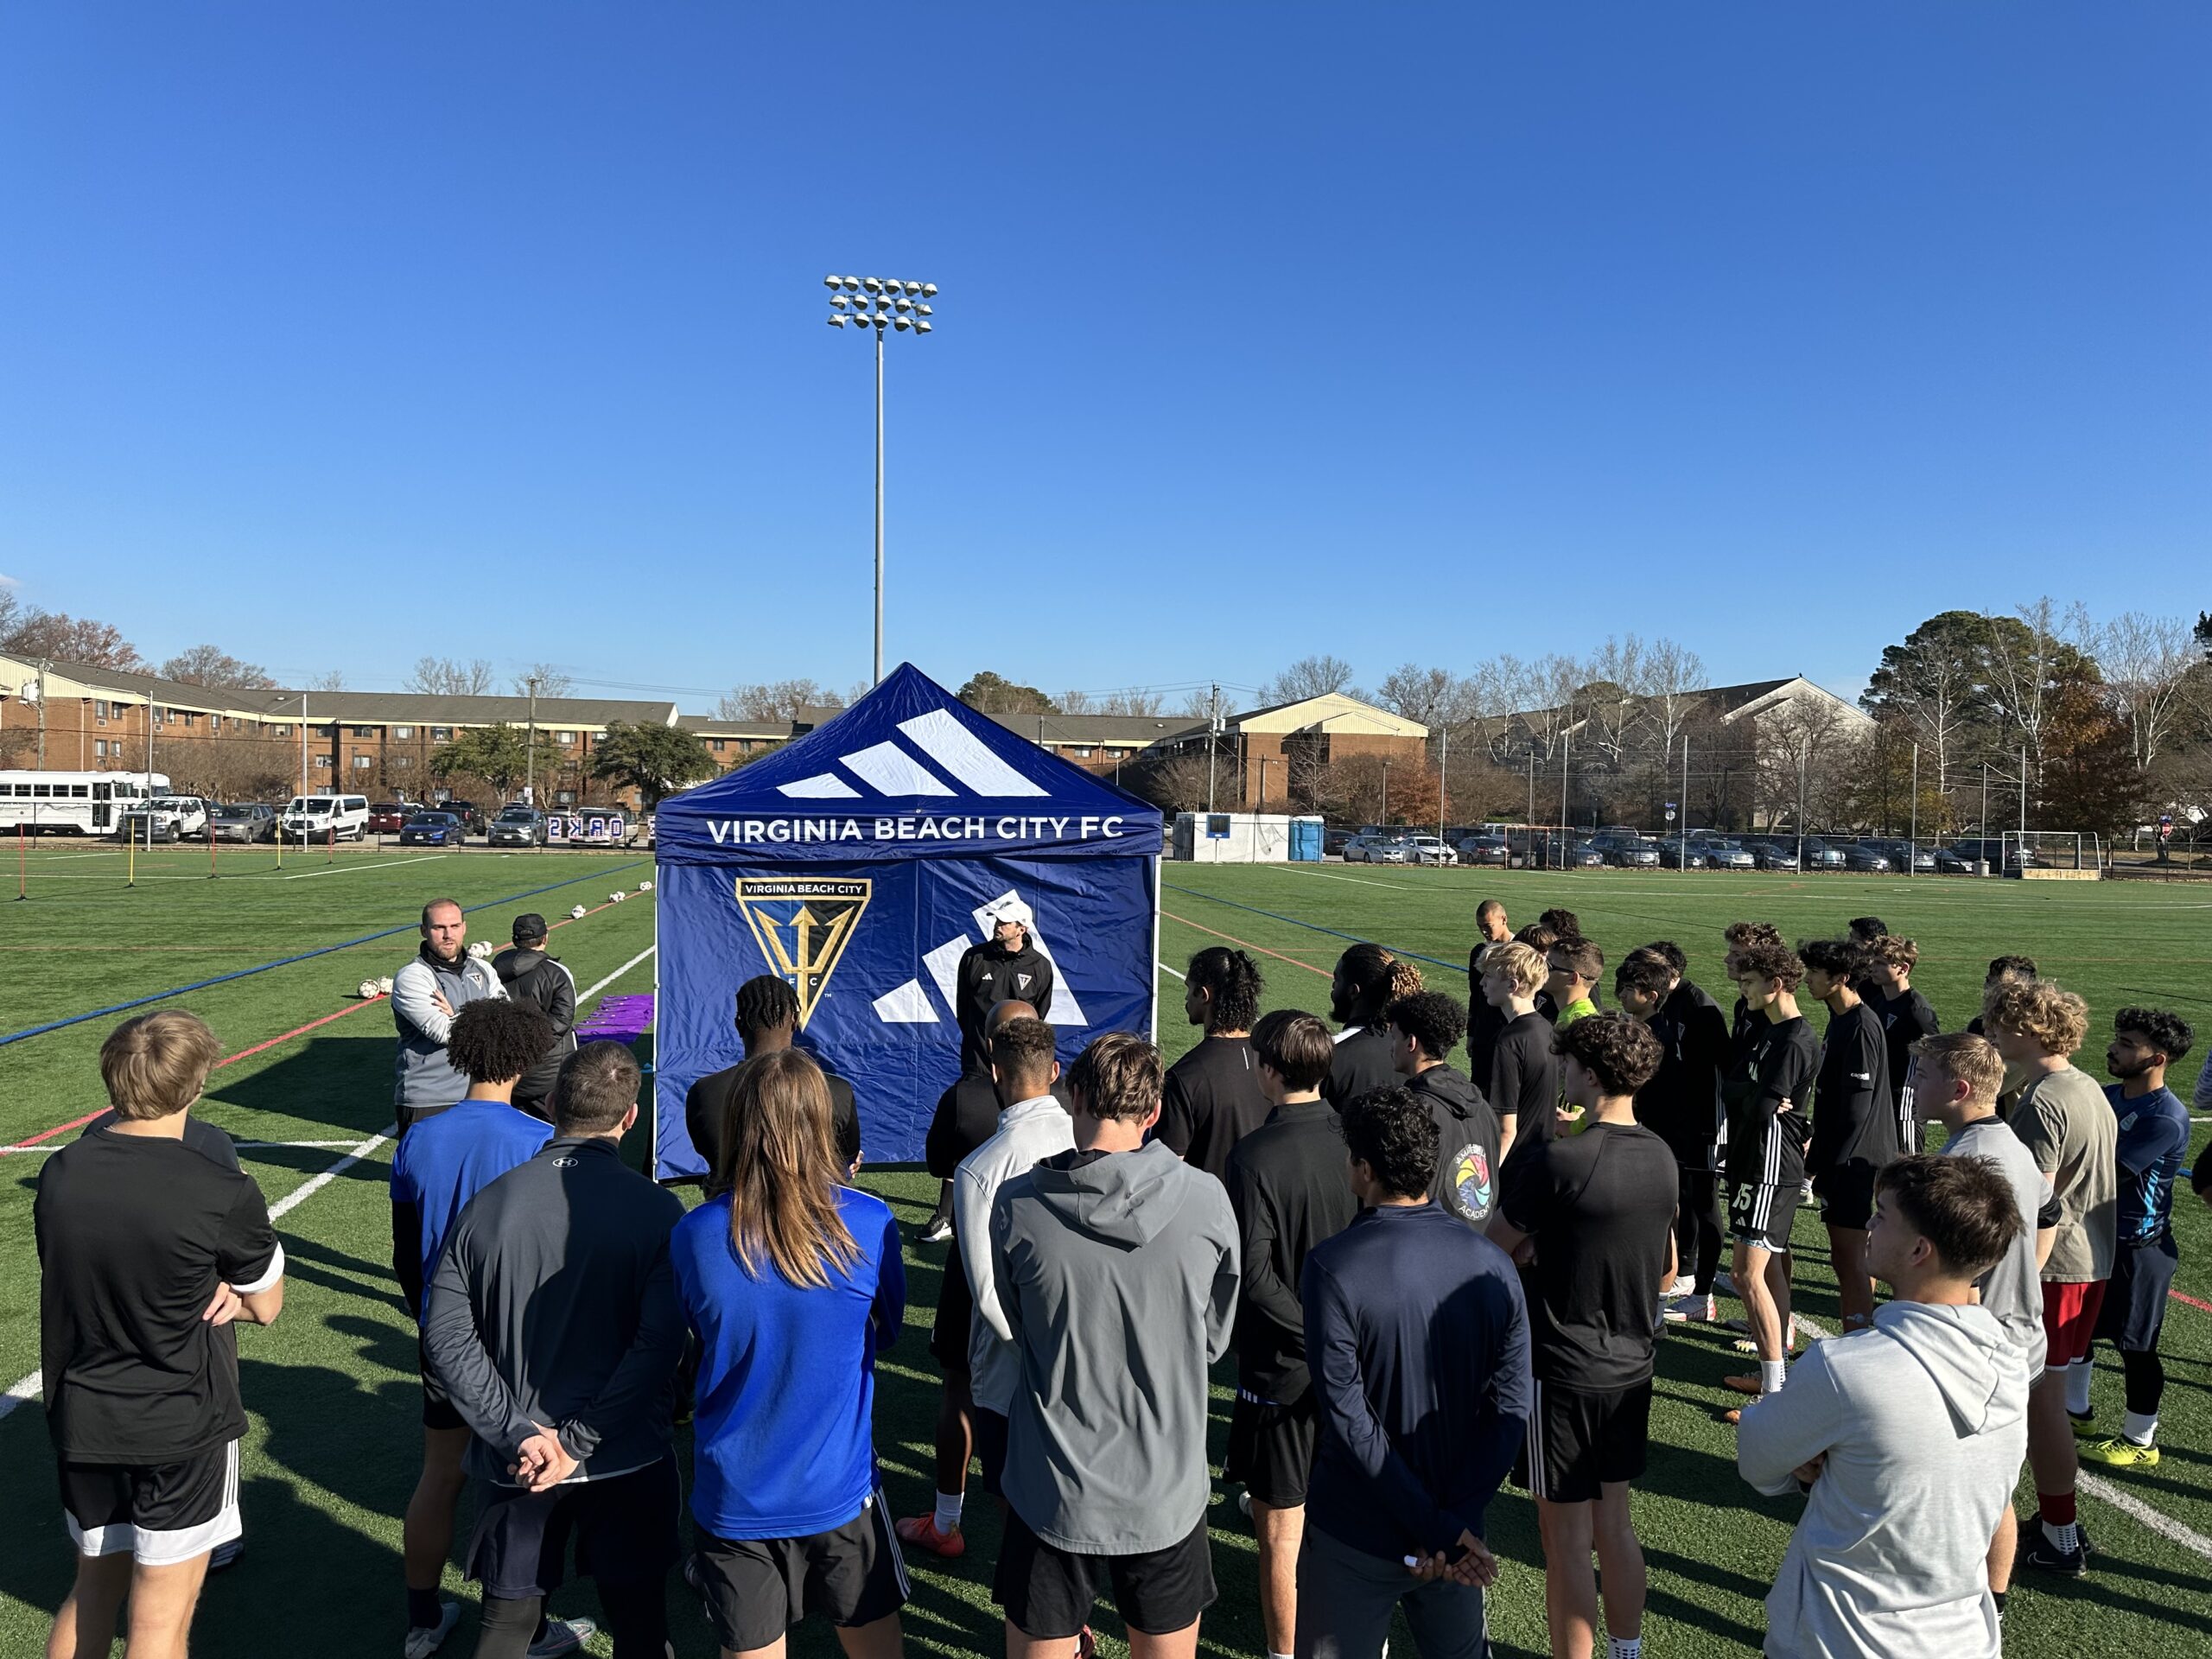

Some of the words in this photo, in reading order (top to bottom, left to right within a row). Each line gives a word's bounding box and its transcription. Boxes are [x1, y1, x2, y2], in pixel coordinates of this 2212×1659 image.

[707, 818, 863, 843] VIRGINIA
[874, 817, 985, 840] BEACH
[996, 817, 1070, 840] CITY
[1081, 816, 1124, 839] FC
[745, 884, 796, 893] VIRGINIA
[798, 884, 835, 893] BEACH
[837, 885, 862, 893] CITY
[809, 977, 817, 986] C
[1459, 1202, 1490, 1219] ACADEMY
